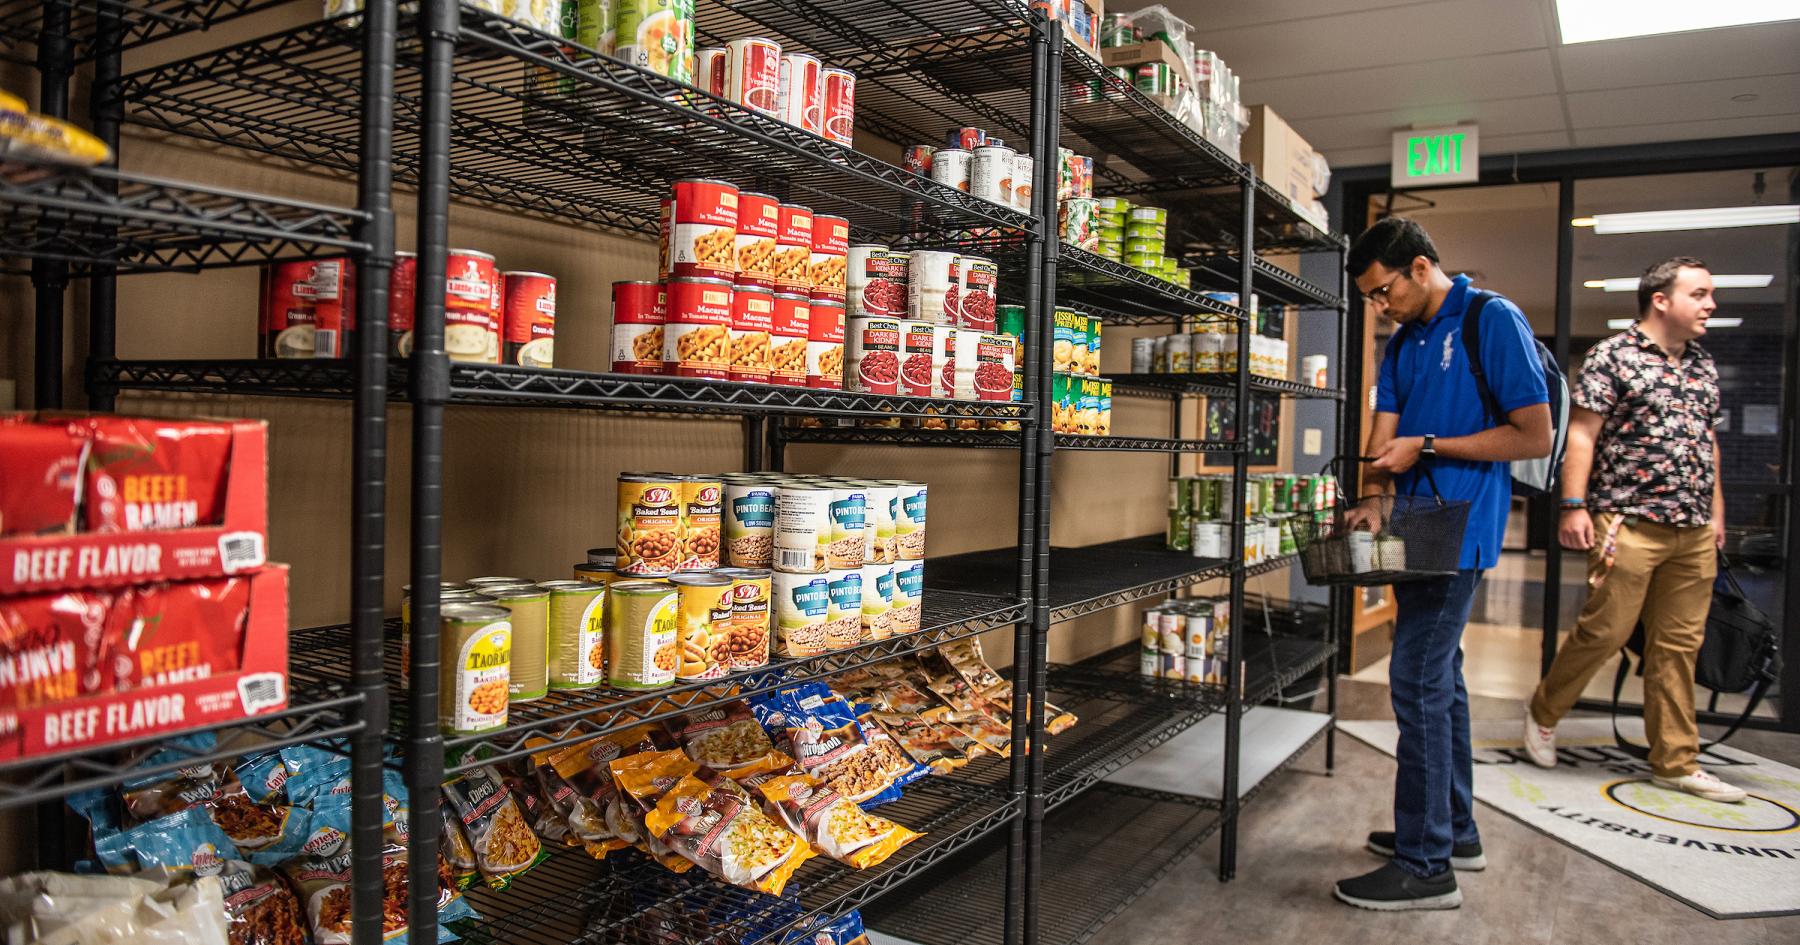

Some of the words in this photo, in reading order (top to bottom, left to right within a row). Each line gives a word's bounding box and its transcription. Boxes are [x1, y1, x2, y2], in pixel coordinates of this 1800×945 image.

[904, 153, 923, 168] Ripe
[1407, 133, 1464, 176] EXIT
[715, 207, 737, 217] Macaro
[689, 313, 709, 321] Tomato
[635, 506, 660, 516] Baked
[690, 506, 712, 515] Baked
[736, 503, 758, 514] PINTO
[759, 504, 774, 513] BEA
[835, 506, 857, 517] PINTO
[125, 500, 199, 530] RAMEN
[13, 548, 72, 584] BEEF
[78, 543, 162, 579] FLAVOR
[900, 576, 918, 586] PINTO
[796, 591, 818, 603] PINTO
[831, 585, 852, 597] PINTO
[44, 703, 100, 745] BEEF
[106, 693, 186, 735] FLAVOR
[1537, 805, 1794, 860] UNIVERSITY
